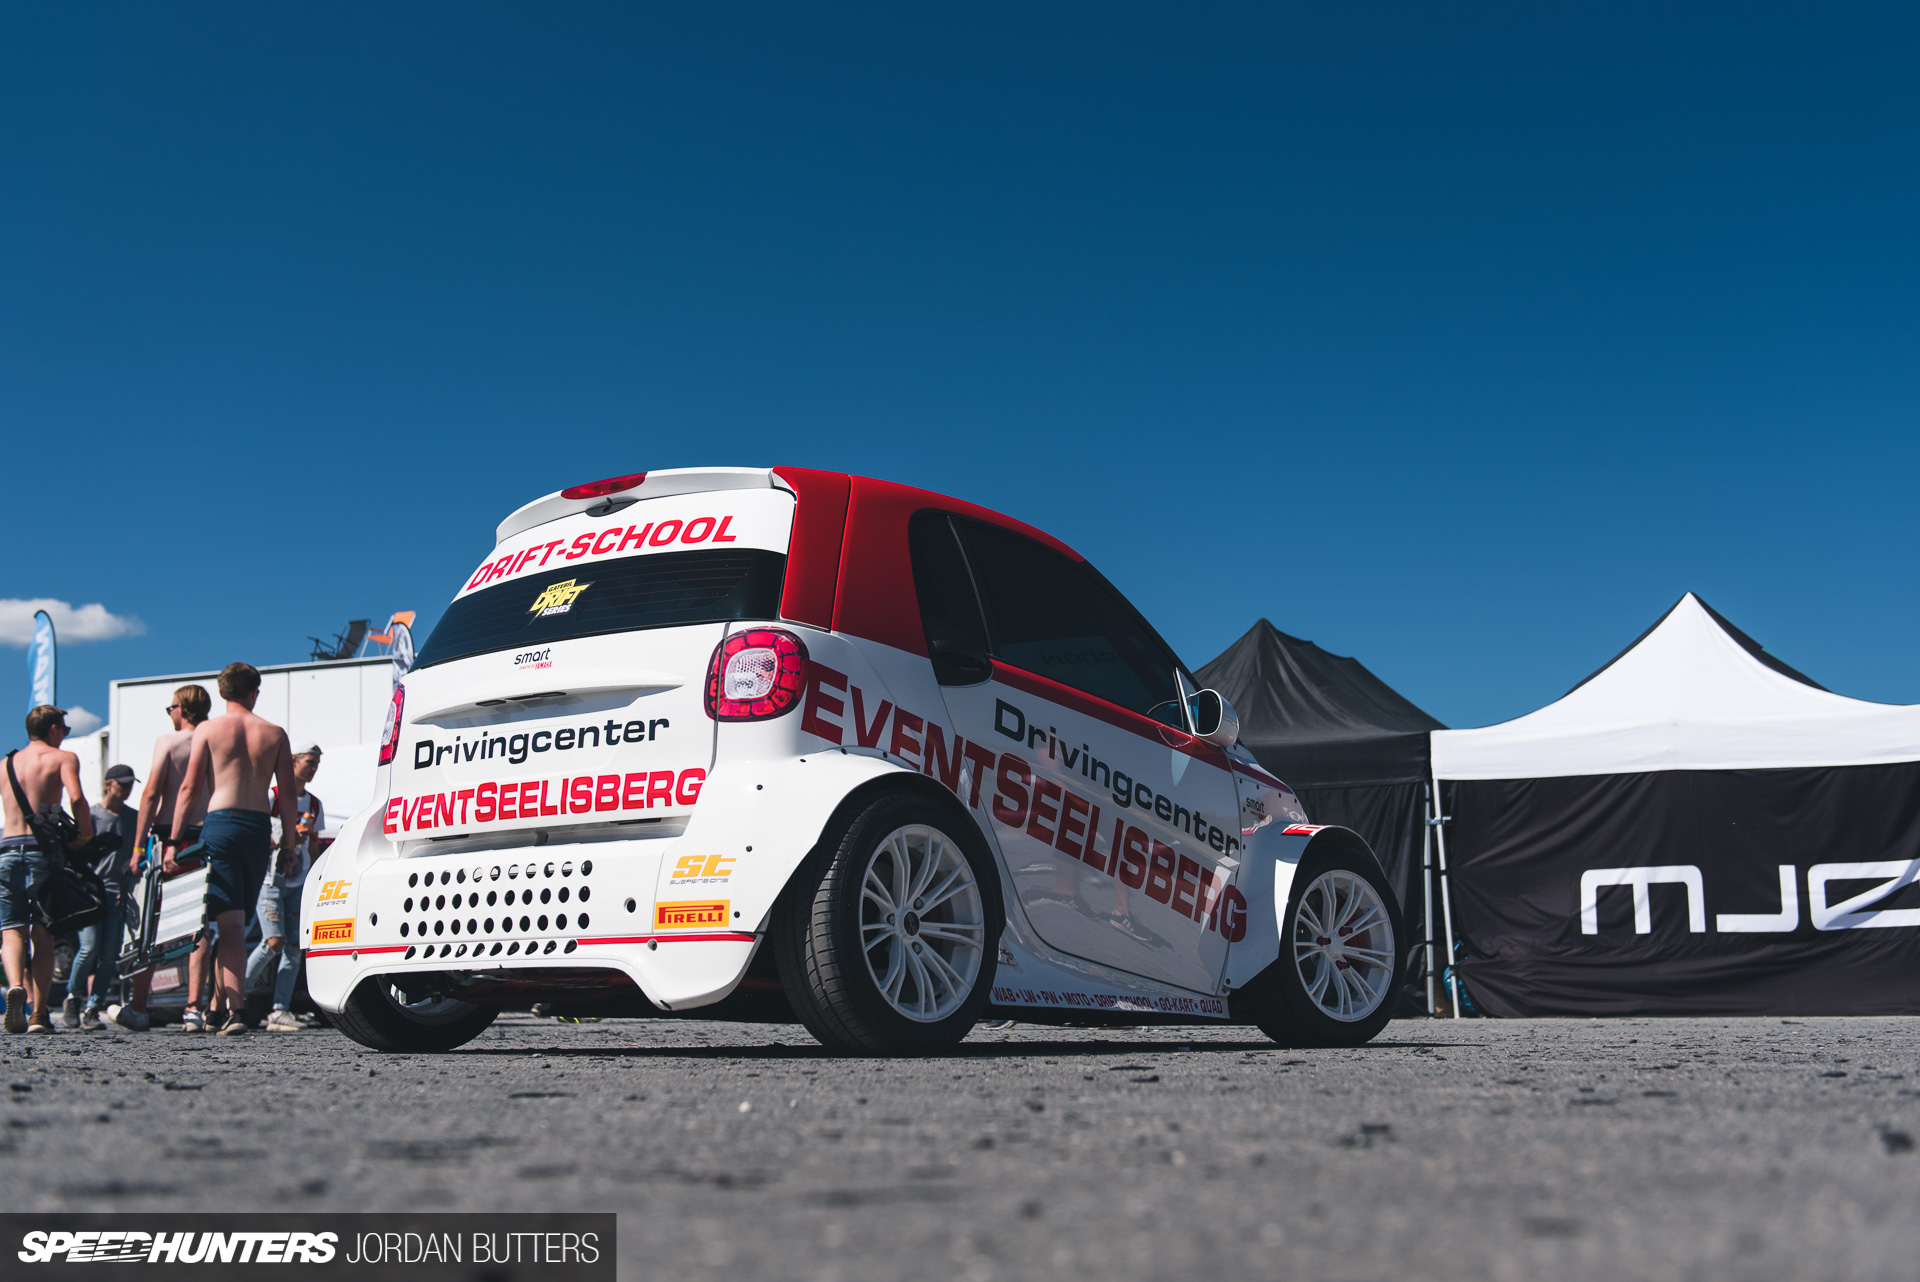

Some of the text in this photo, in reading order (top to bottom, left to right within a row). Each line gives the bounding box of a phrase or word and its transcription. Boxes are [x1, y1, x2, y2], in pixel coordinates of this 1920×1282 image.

[466, 515, 737, 591] DRIFT-SCHOOL
[529, 583, 590, 618] DRIFT
[541, 604, 571, 616] SERIES
[514, 647, 551, 665] smart
[413, 717, 670, 770] Drivingcenter
[994, 697, 1240, 858] Drivingcenter
[383, 767, 706, 835] EVENTSEELISBERG
[801, 659, 1248, 943] EVENTSEELISBERG
[314, 922, 352, 940] PIRELLI
[658, 904, 724, 924] PIRELLI
[992, 987, 1016, 1002] WAB
[1062, 992, 1091, 1006] MOTO
[1158, 997, 1195, 1012] GO-KART
[1200, 999, 1223, 1014] QUAD
